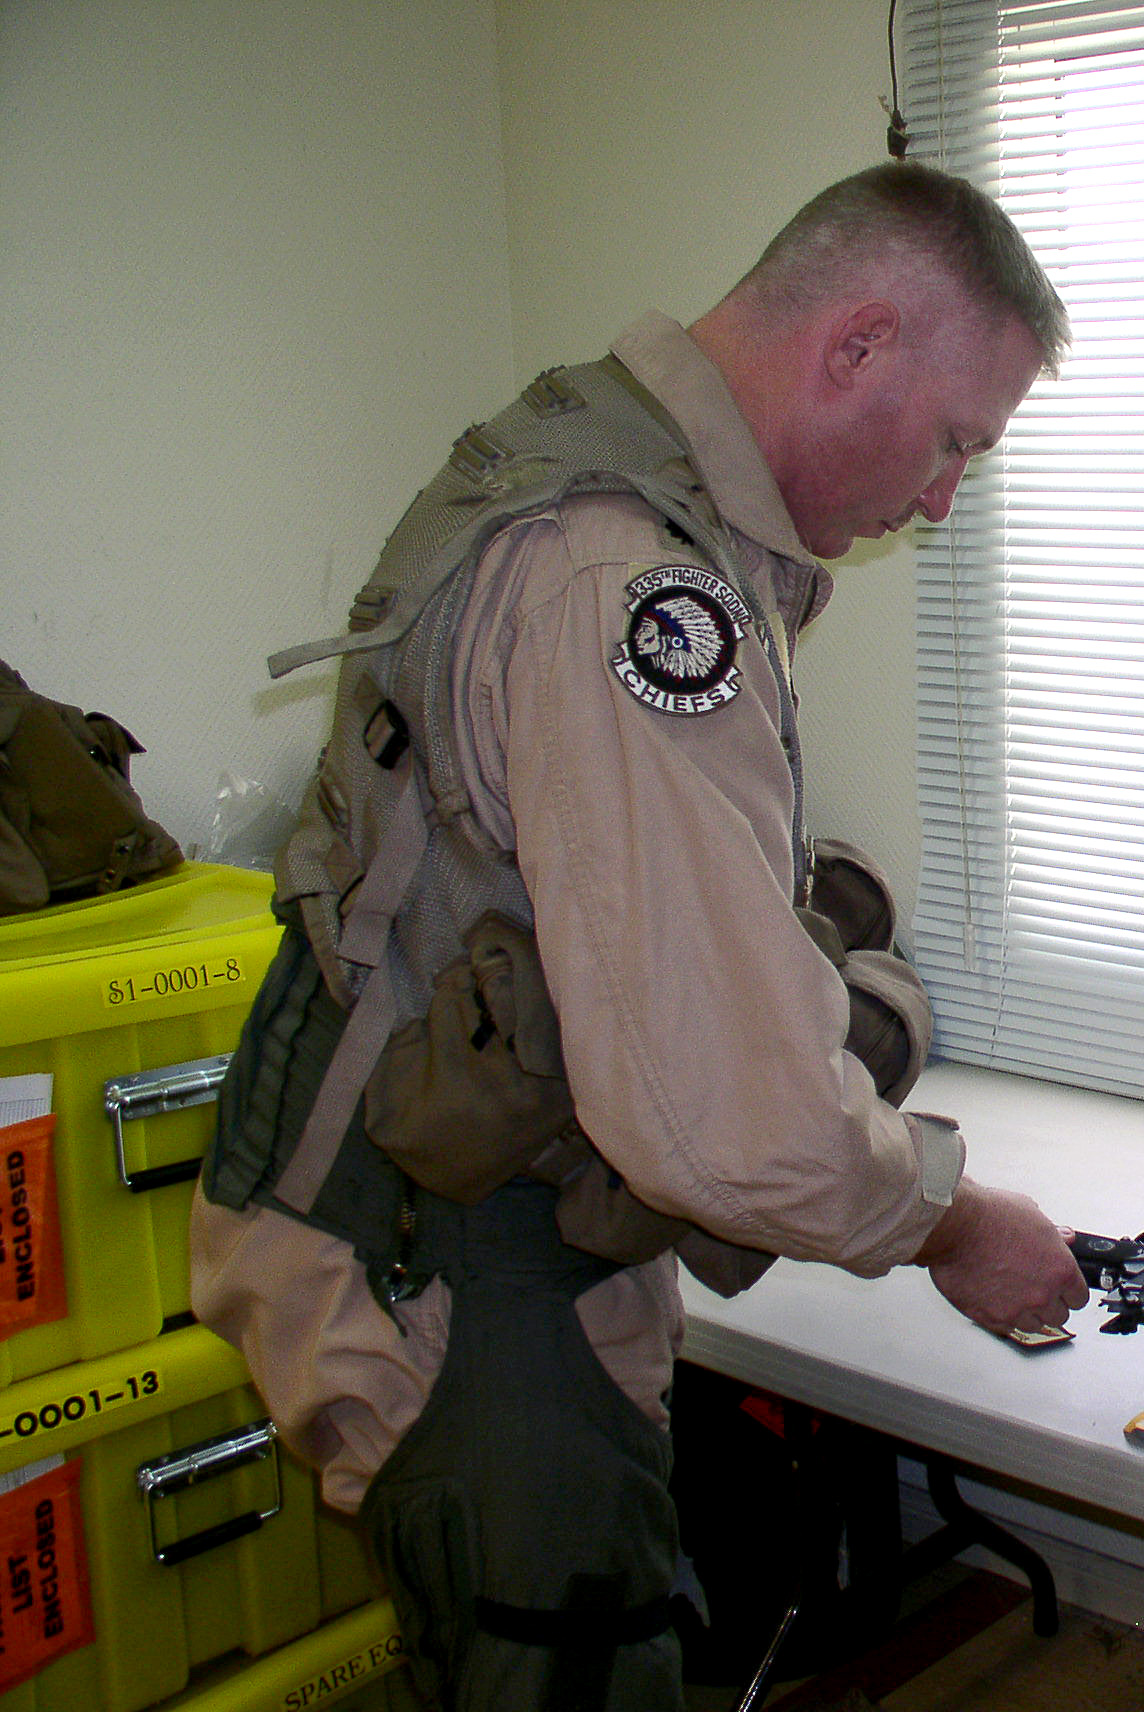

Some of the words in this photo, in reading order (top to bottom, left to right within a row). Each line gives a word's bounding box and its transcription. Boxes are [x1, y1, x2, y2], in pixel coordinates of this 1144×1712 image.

[672, 569, 718, 595] FIGHTER
[623, 669, 725, 711] CHIEFS
[109, 958, 241, 1005] S1-0001-8
[7, 1151, 36, 1302] ENCLOSED
[8, 1555, 33, 1614] LIST
[35, 1499, 64, 1638] ENCLOSED
[285, 1655, 366, 1712] SPARE
